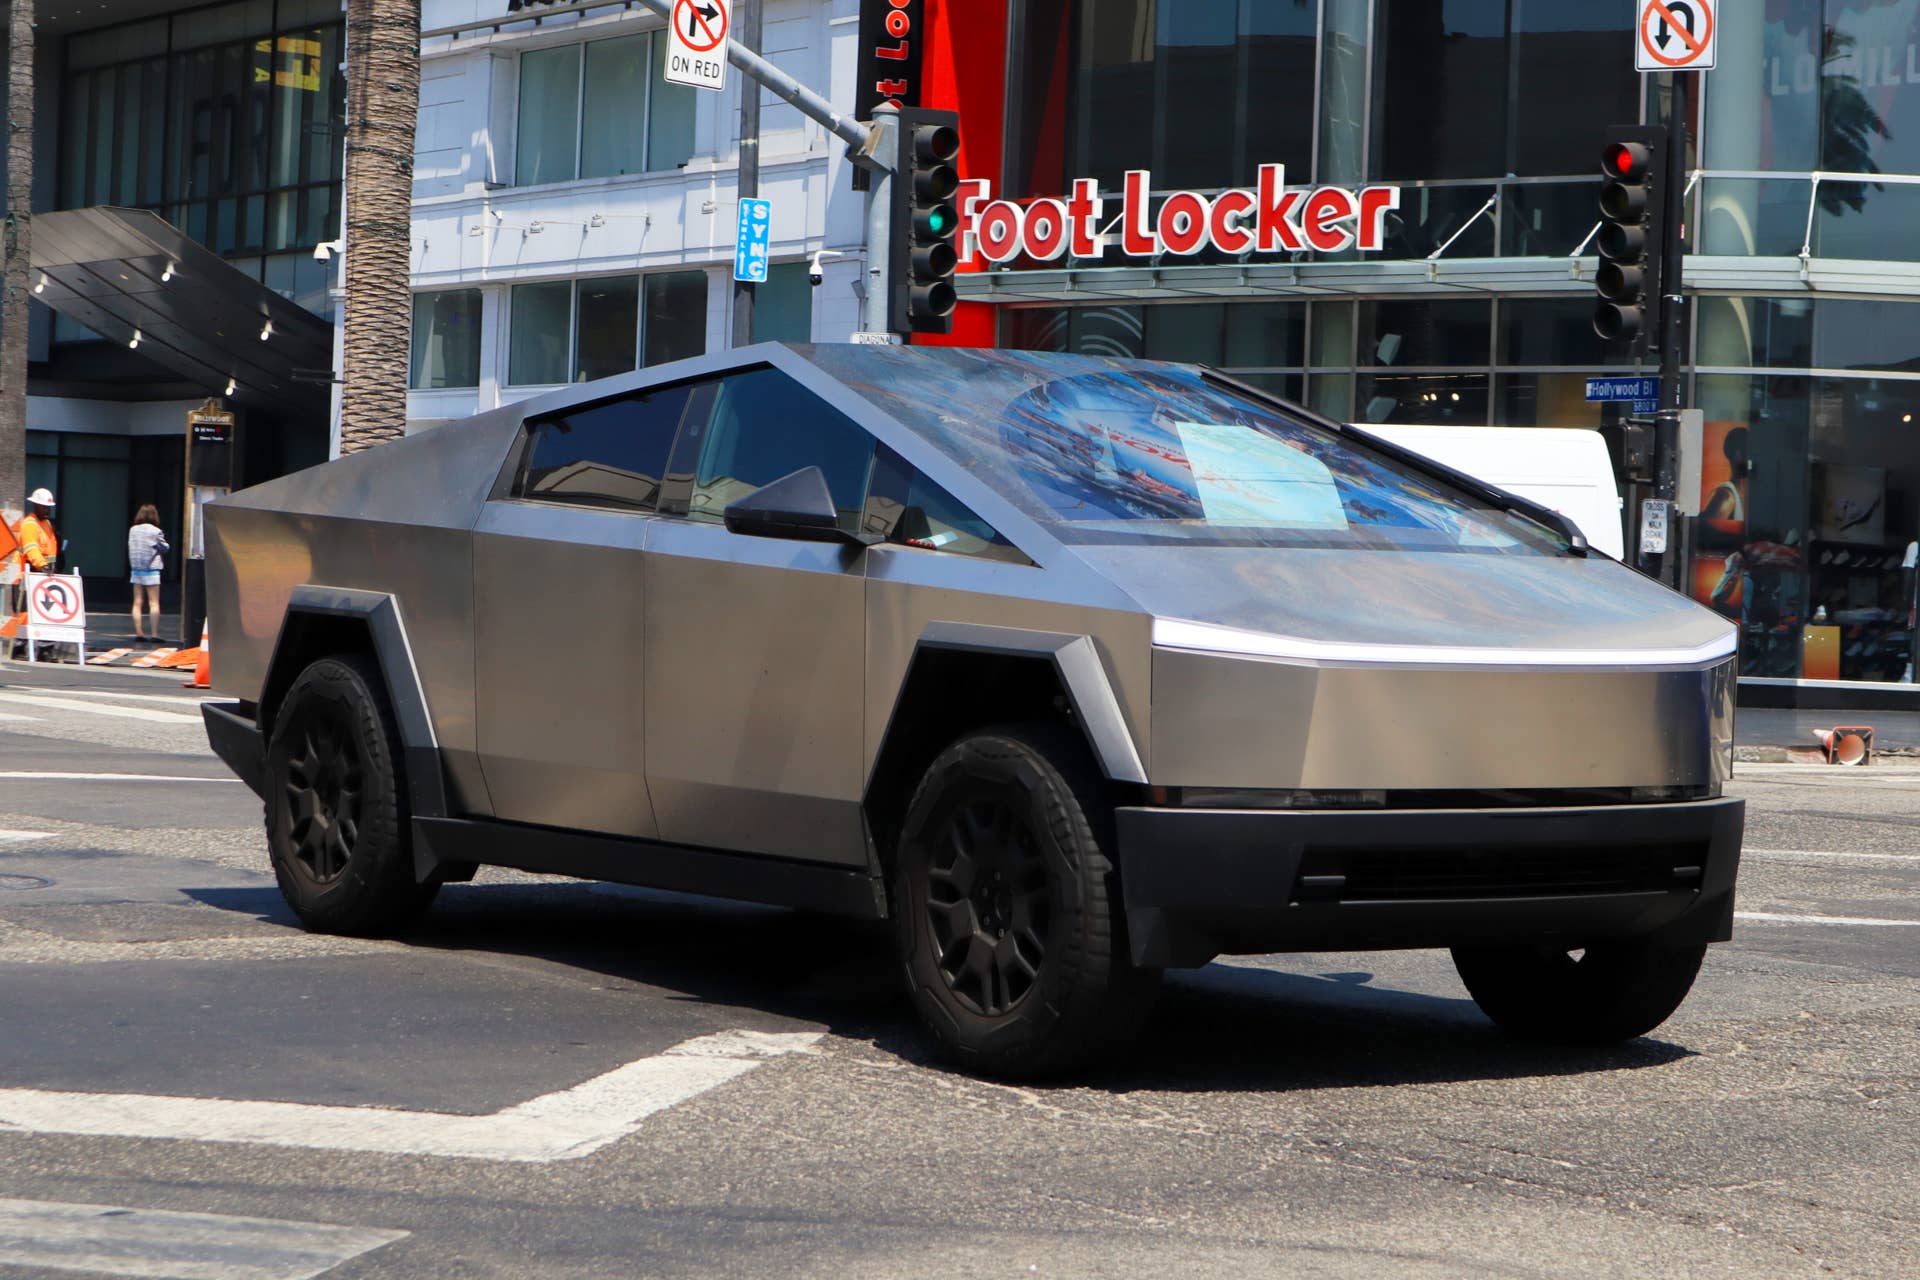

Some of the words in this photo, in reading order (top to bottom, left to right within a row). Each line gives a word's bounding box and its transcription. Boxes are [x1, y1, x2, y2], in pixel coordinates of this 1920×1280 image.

[672, 55, 689, 73] ON
[694, 59, 720, 79] RED
[876, 79, 906, 110] t
[957, 178, 1104, 263] Foot
[1123, 163, 1400, 257] Locker
[748, 204, 767, 277] SYNC
[1592, 381, 1640, 399] Hollywood
